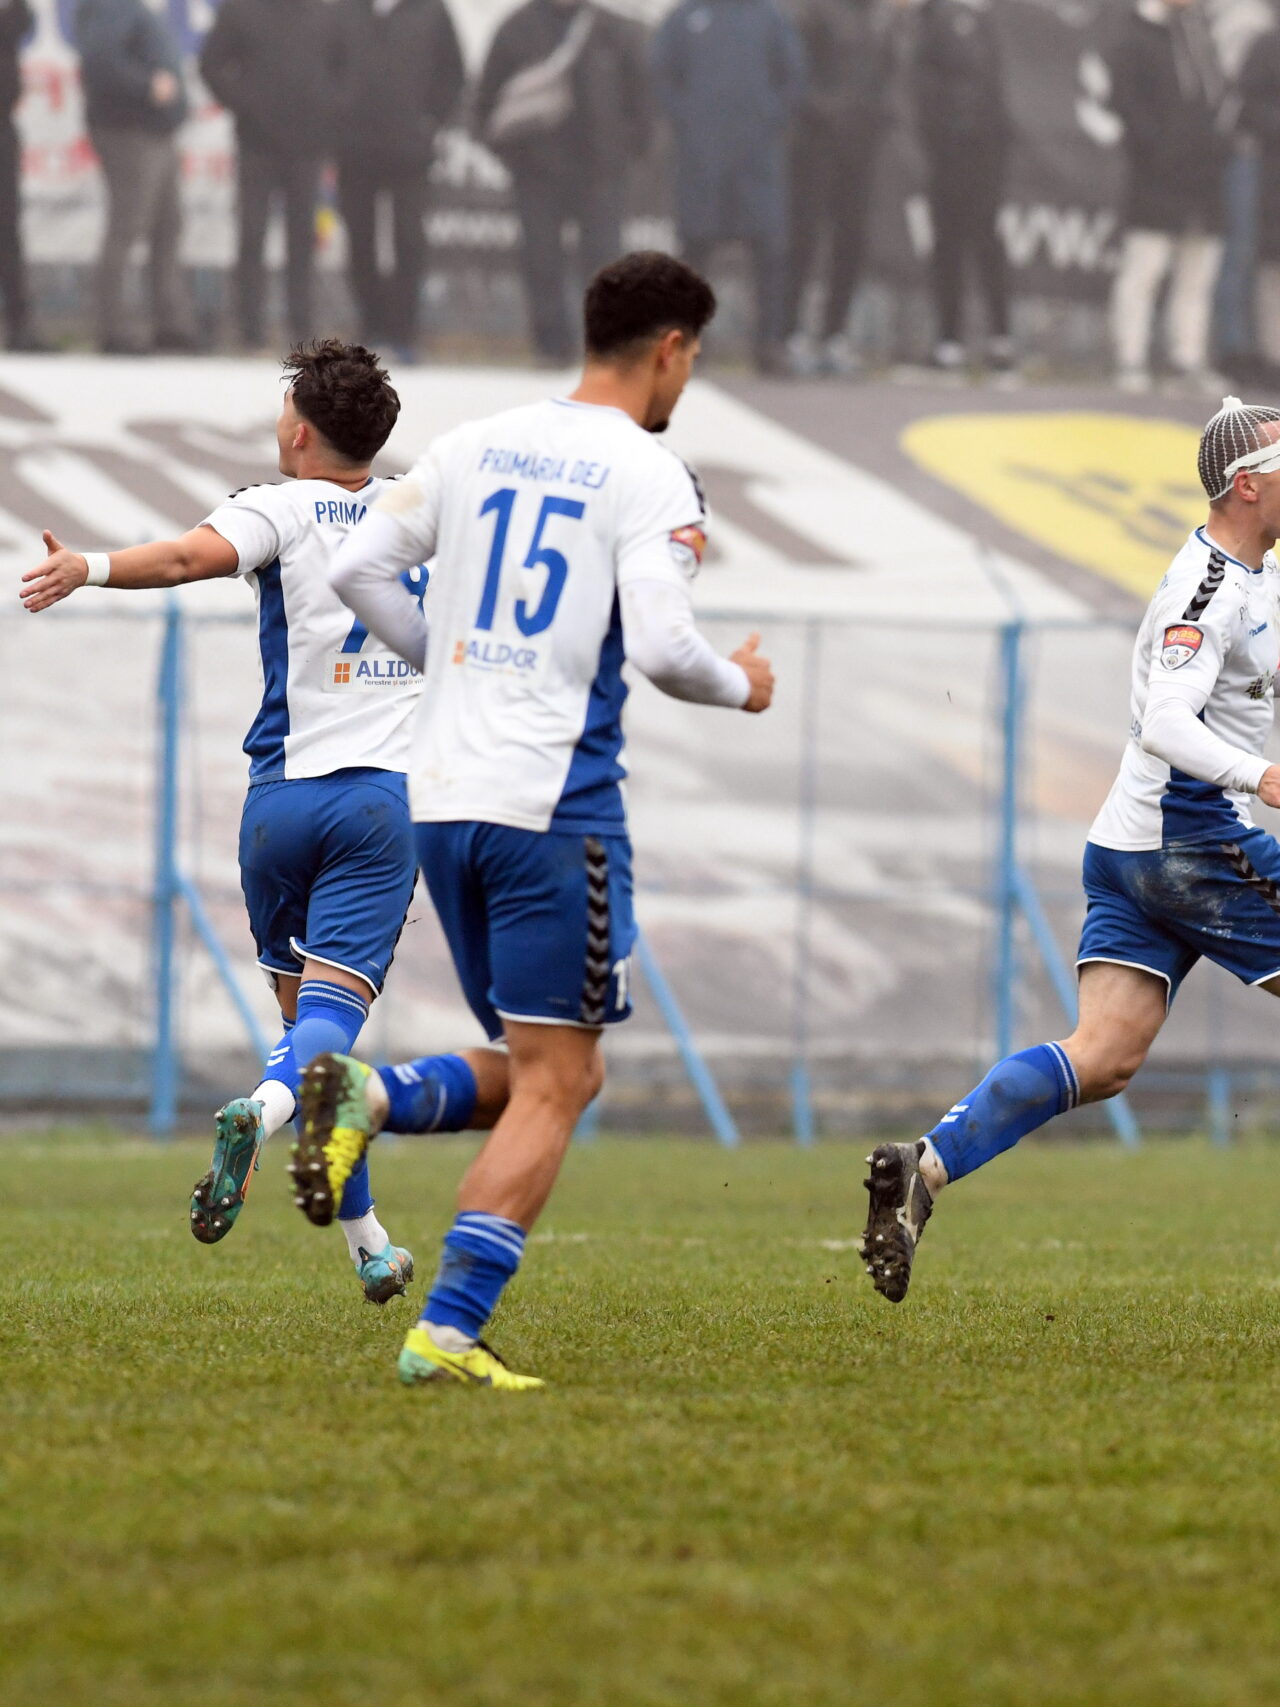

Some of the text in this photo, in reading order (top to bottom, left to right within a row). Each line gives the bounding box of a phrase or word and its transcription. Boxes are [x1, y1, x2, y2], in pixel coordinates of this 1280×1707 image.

[568, 459, 611, 489] DEJ
[474, 487, 586, 638] 15
[356, 660, 420, 678] ALIDO
[465, 640, 538, 671] ALDOR
